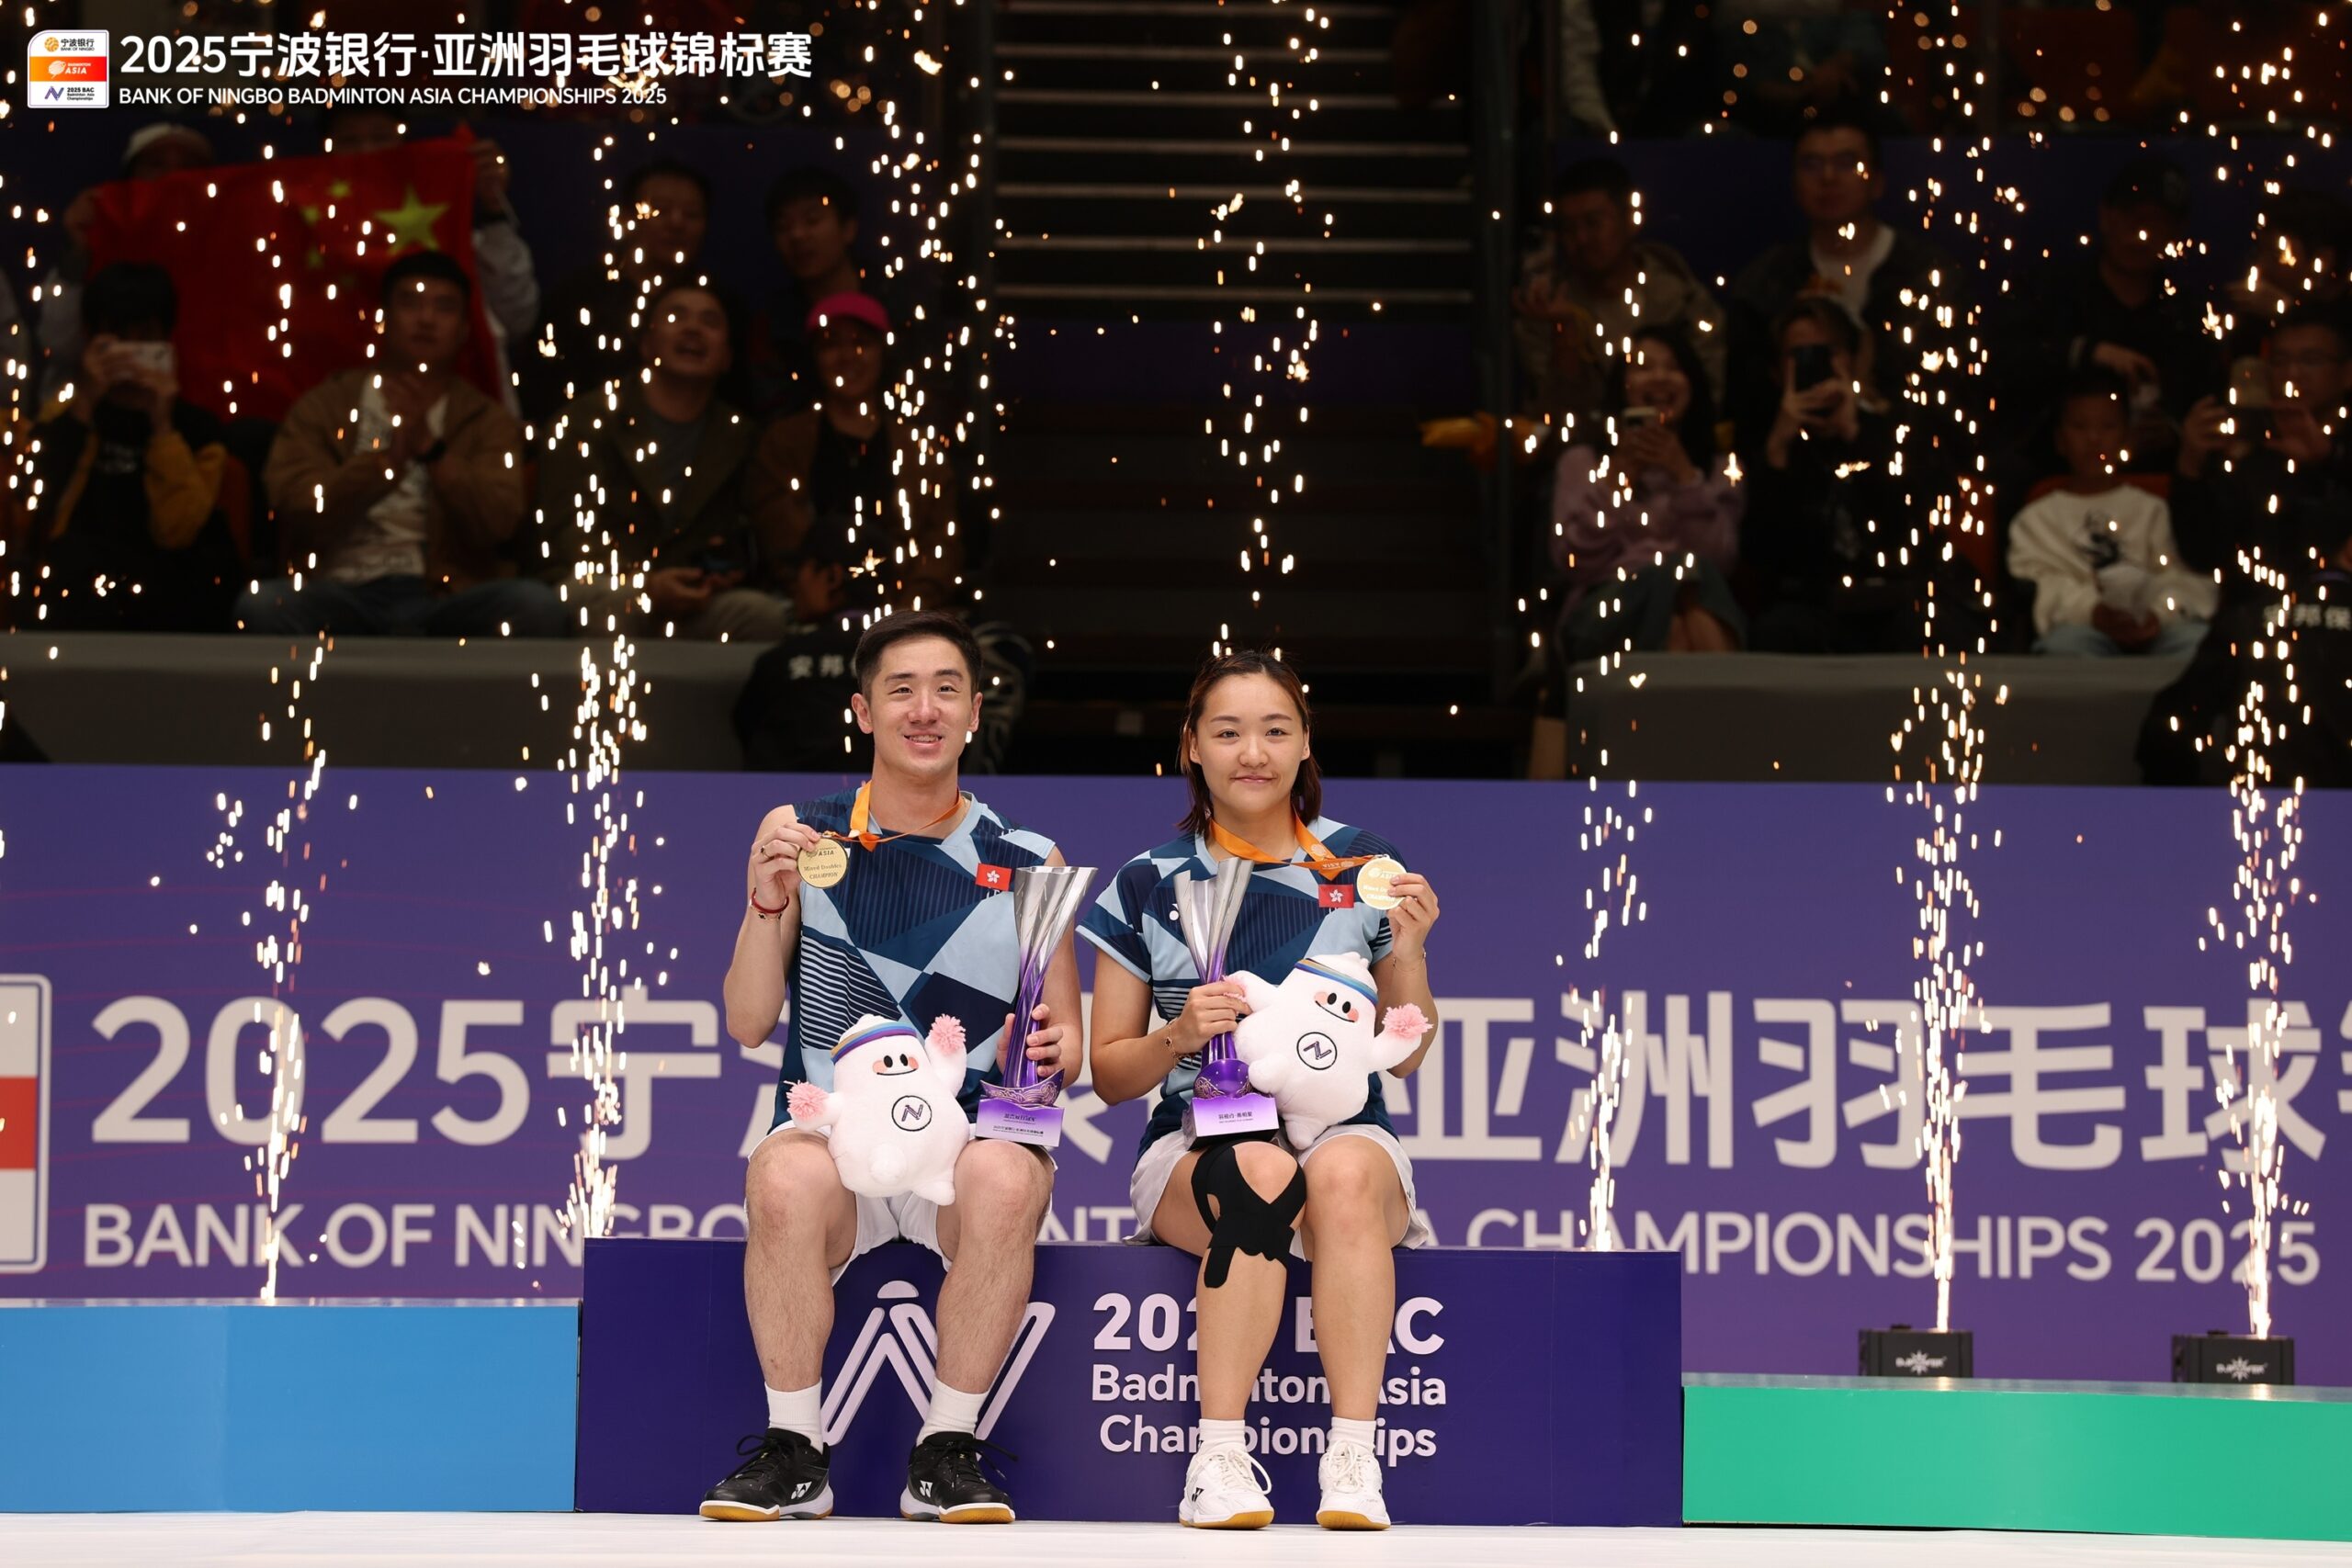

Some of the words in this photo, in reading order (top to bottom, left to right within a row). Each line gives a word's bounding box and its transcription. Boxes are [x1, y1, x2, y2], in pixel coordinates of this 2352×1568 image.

[789, 653, 856, 680] 安邦
[84, 1203, 304, 1268] BANK
[325, 1203, 435, 1269] OF
[1093, 1292, 1198, 1352] 20
[1091, 1363, 1330, 1404] Badton
[1100, 1414, 1437, 1468] Chaionips
